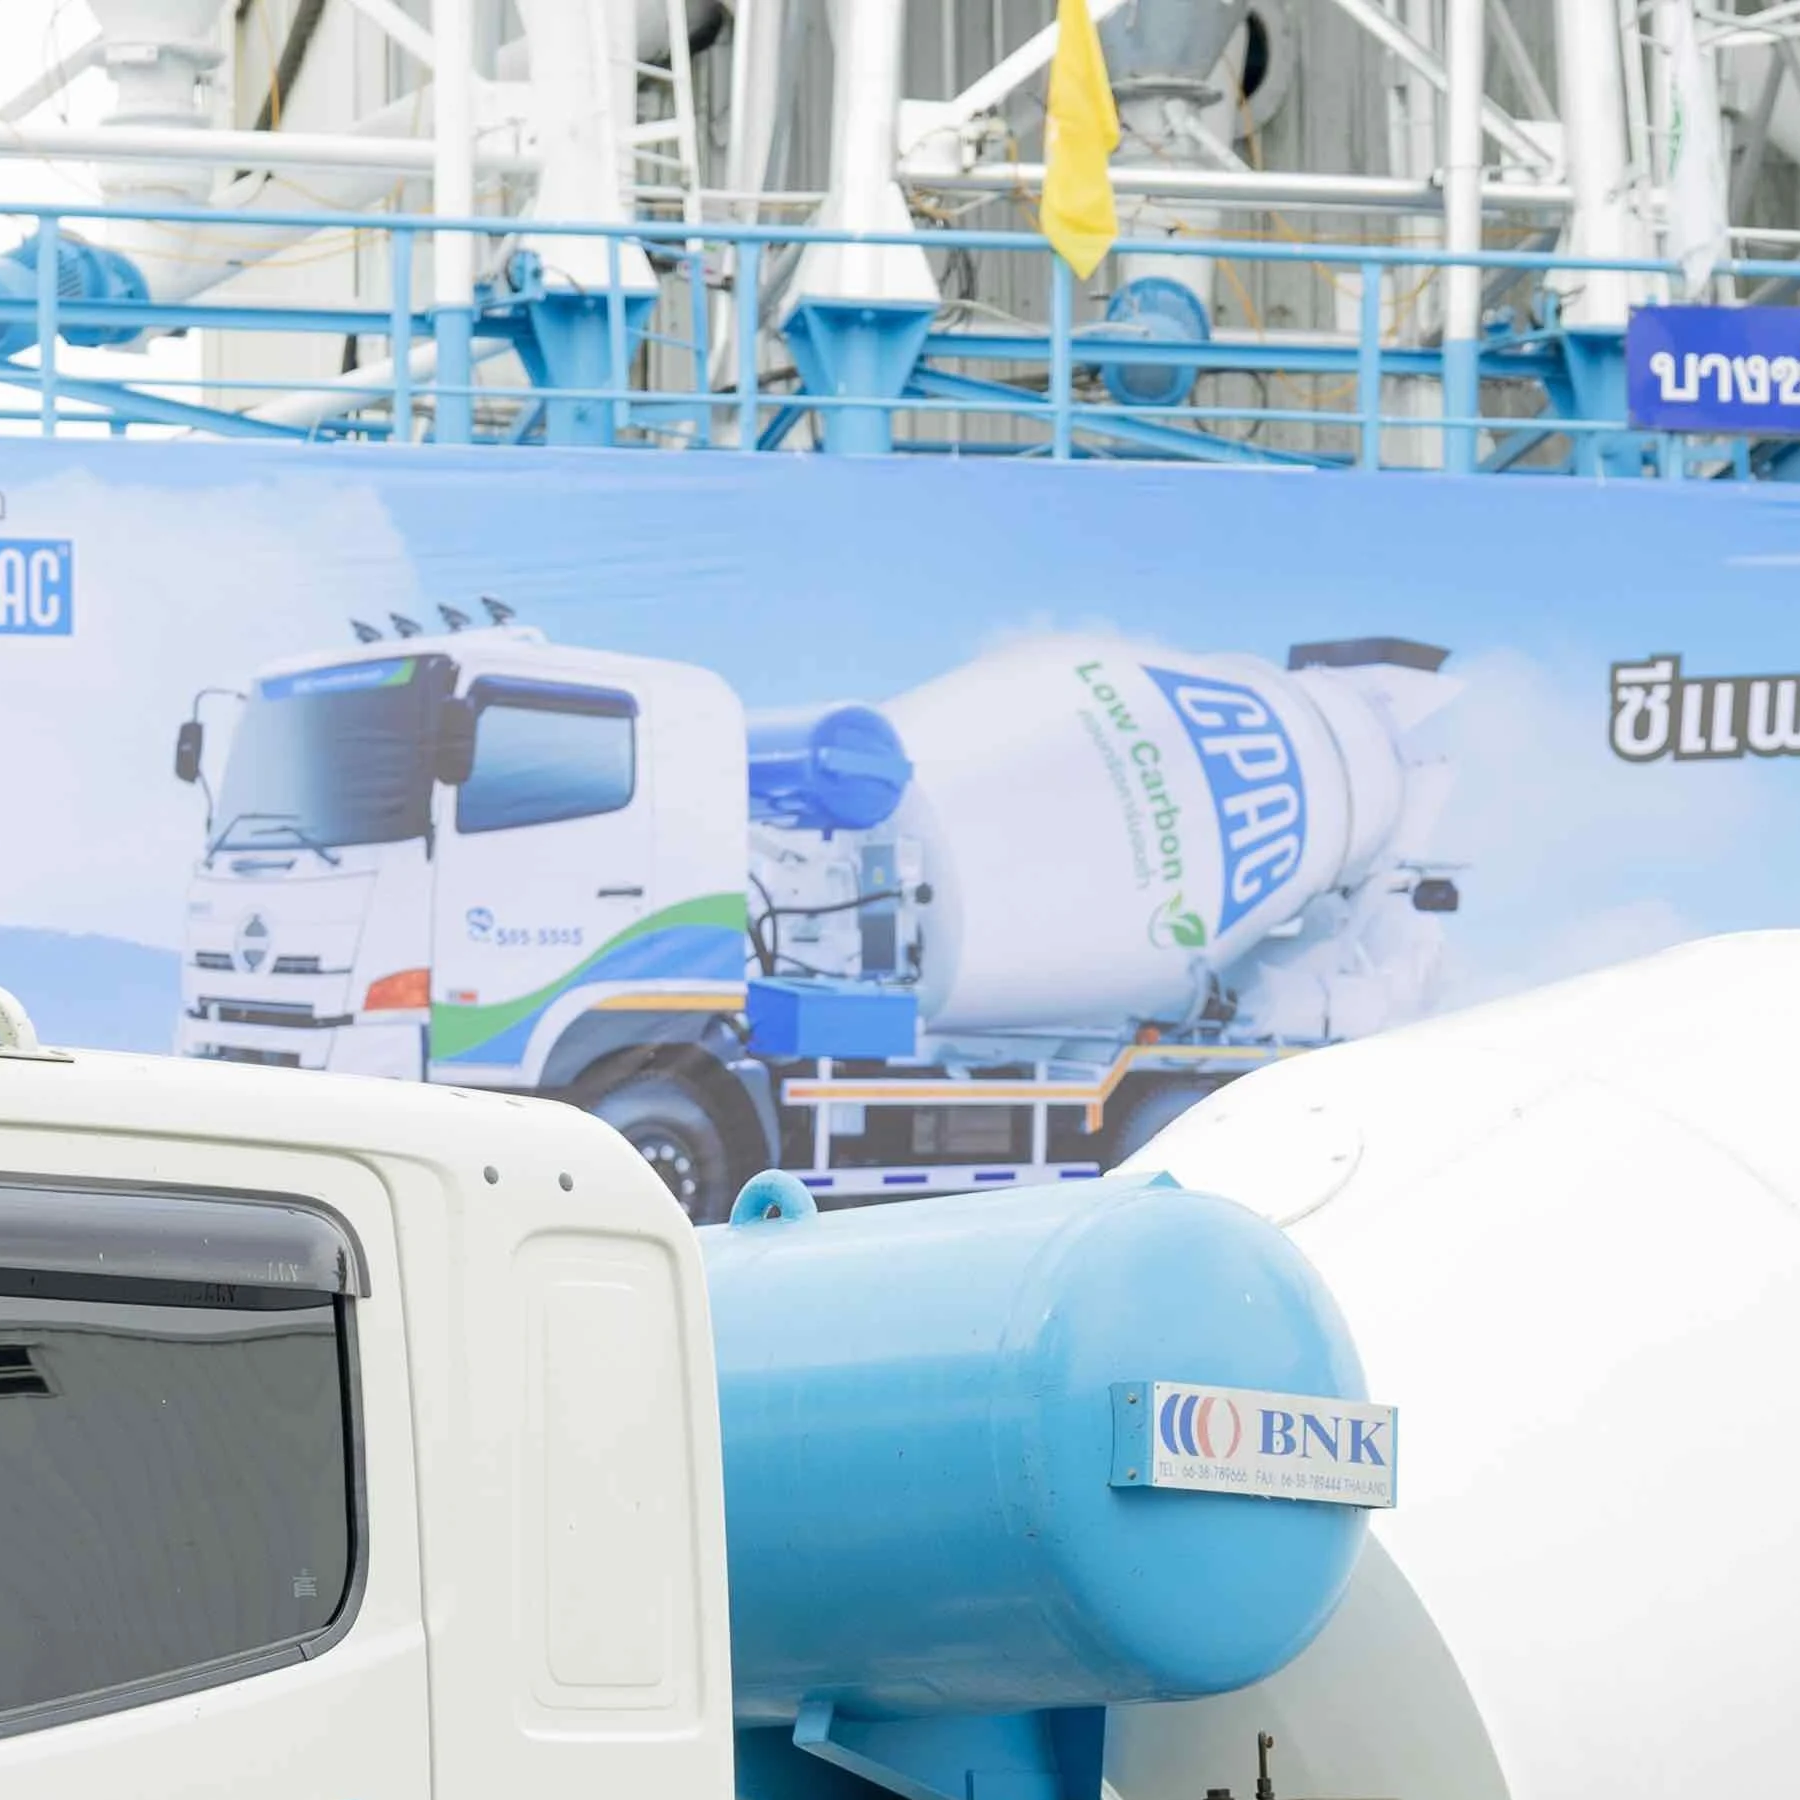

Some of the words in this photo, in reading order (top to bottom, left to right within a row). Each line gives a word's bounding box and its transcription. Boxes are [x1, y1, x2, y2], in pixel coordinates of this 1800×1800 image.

[1075, 660, 1139, 733] Low
[1129, 739, 1183, 883] Carbon
[1174, 684, 1300, 904] CPAC
[1257, 1408, 1387, 1468] BNK
